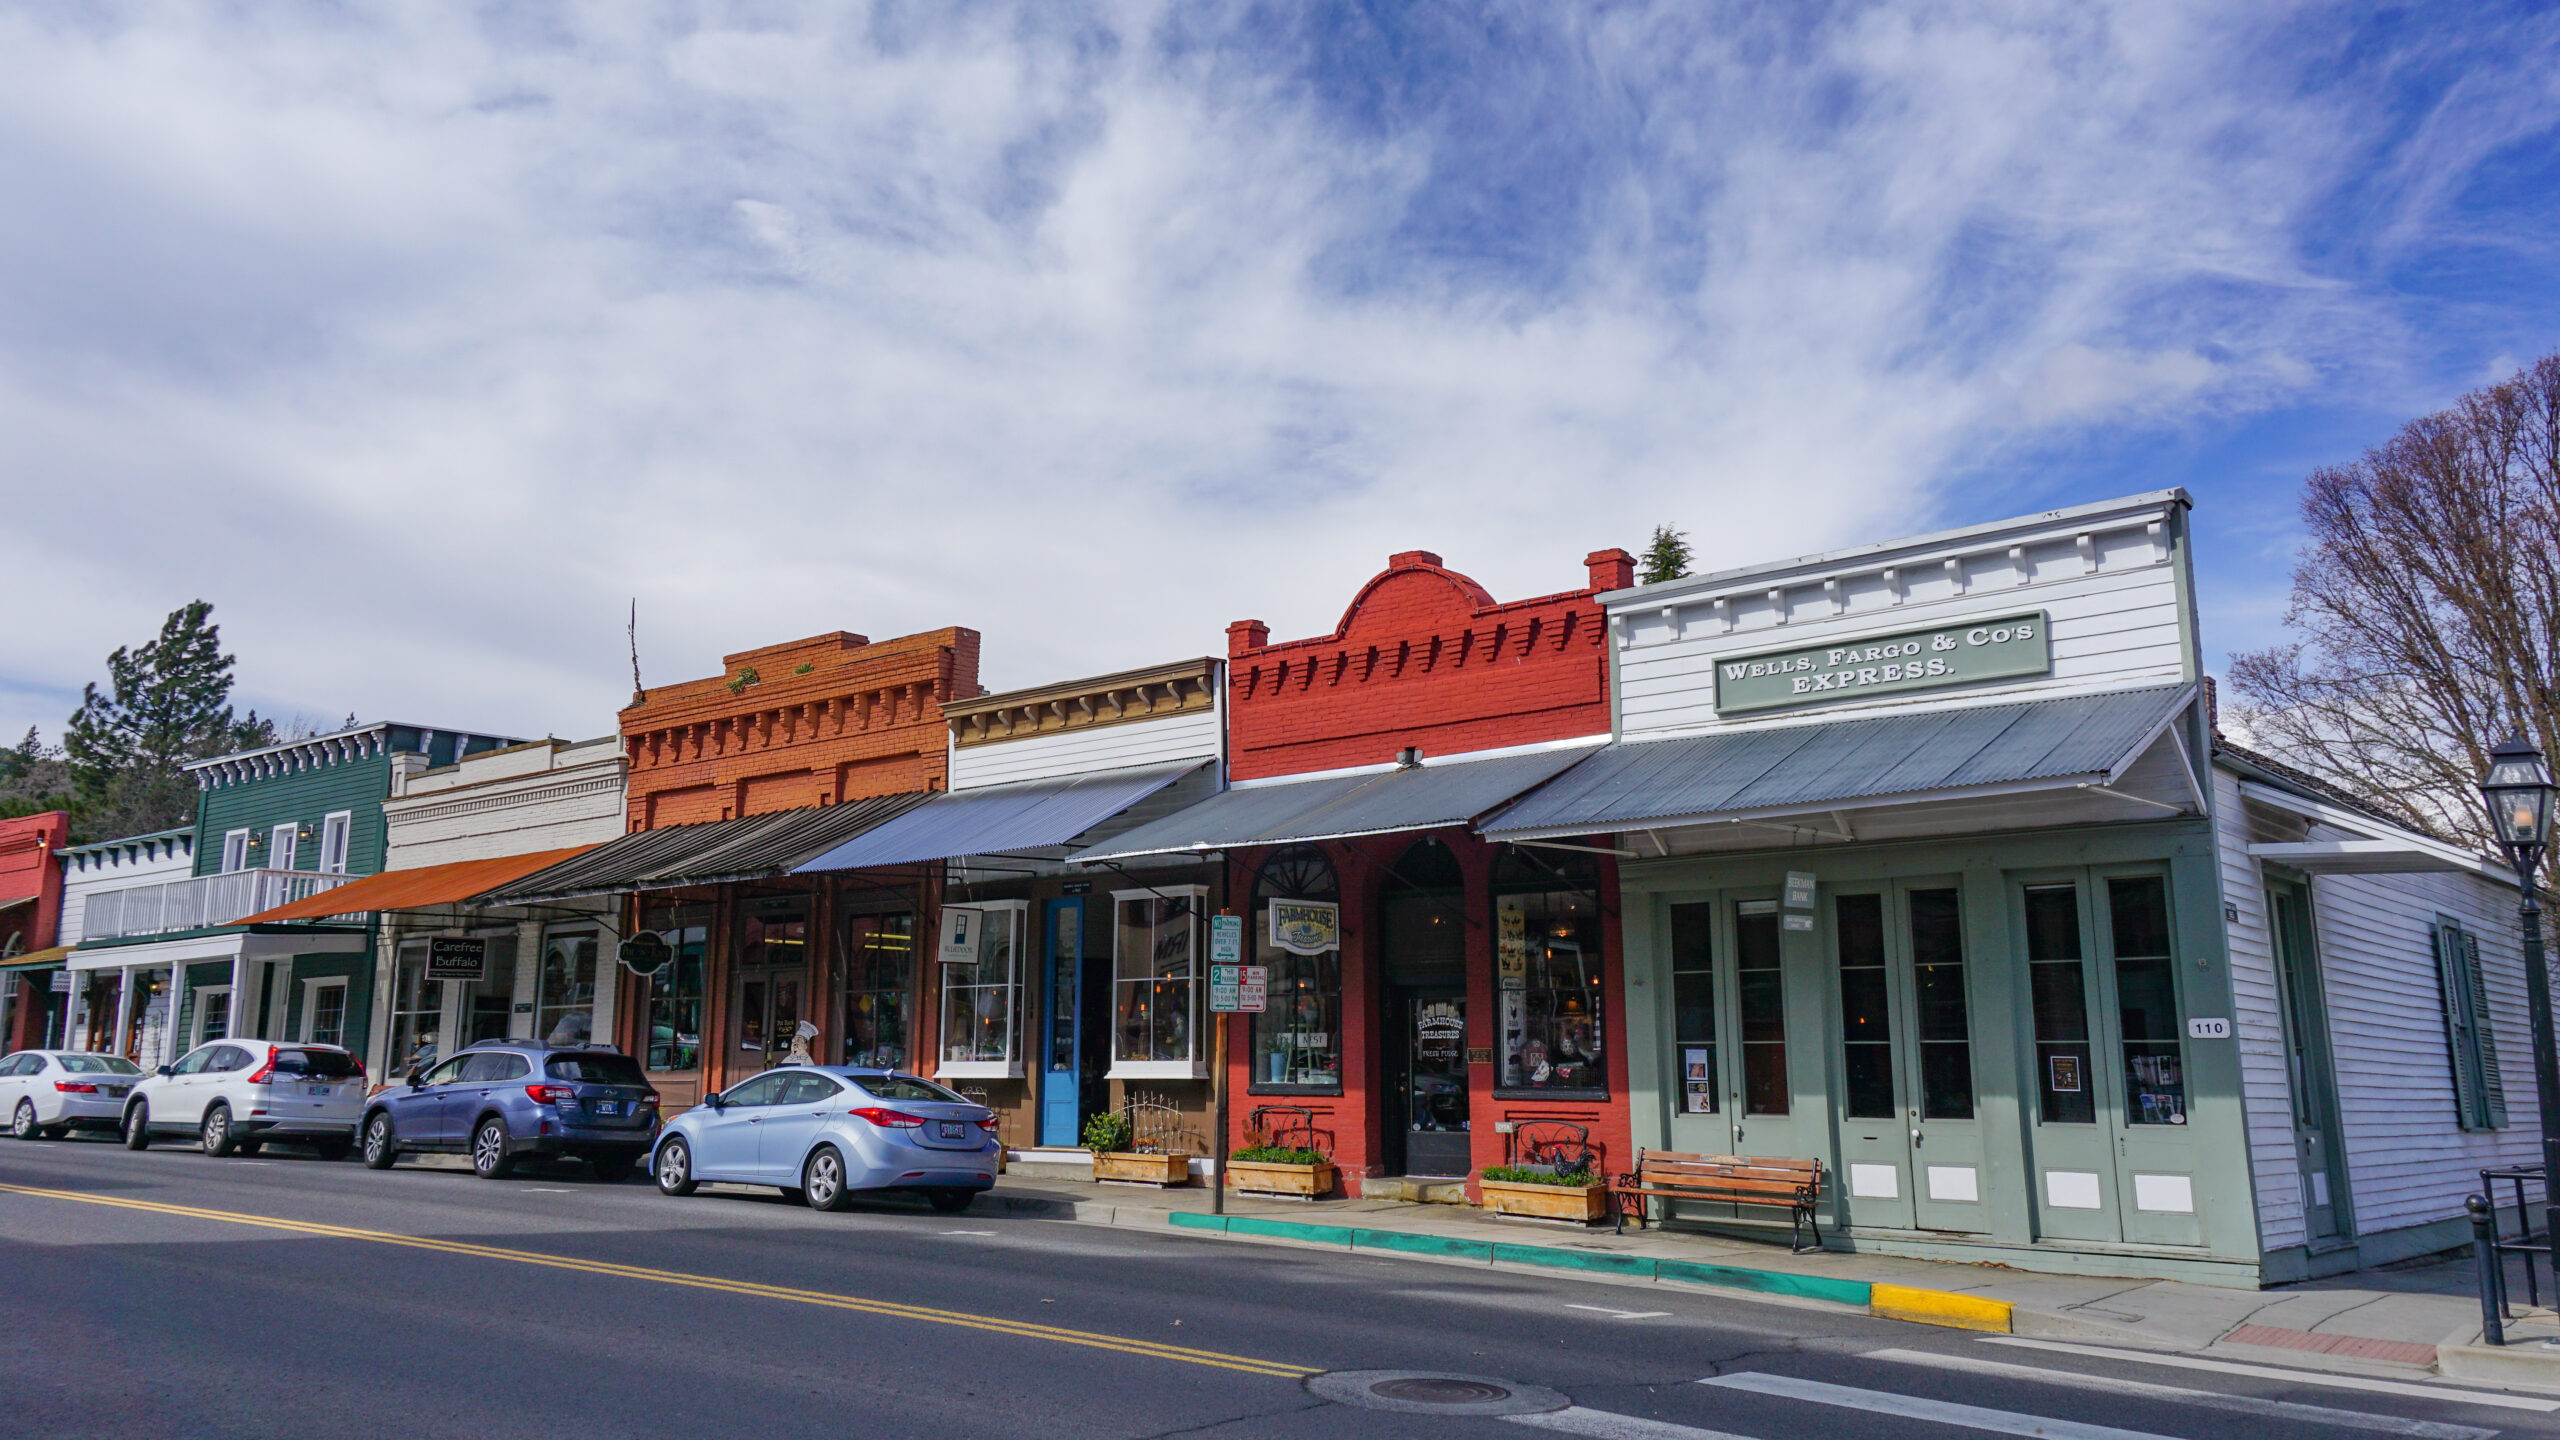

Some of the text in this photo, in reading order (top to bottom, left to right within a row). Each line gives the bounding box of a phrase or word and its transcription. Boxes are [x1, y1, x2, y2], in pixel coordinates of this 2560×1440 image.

[1931, 633, 1957, 652] &
[1791, 657, 1956, 694] EXPRESS.
[1788, 877, 1815, 889] BEEKMAN
[1792, 890, 1809, 902] BANK
[1277, 906, 1335, 929] FARMHOUSE
[1214, 919, 1222, 929] NO
[433, 941, 483, 952] Carefree
[435, 955, 478, 967] Buffalo
[1213, 969, 1220, 982] 2
[1240, 969, 1247, 982] 15
[1417, 1017, 1464, 1030] FARMHOUSE
[2196, 1023, 2223, 1034] 110
[1421, 1030, 1460, 1039] TREASURES
